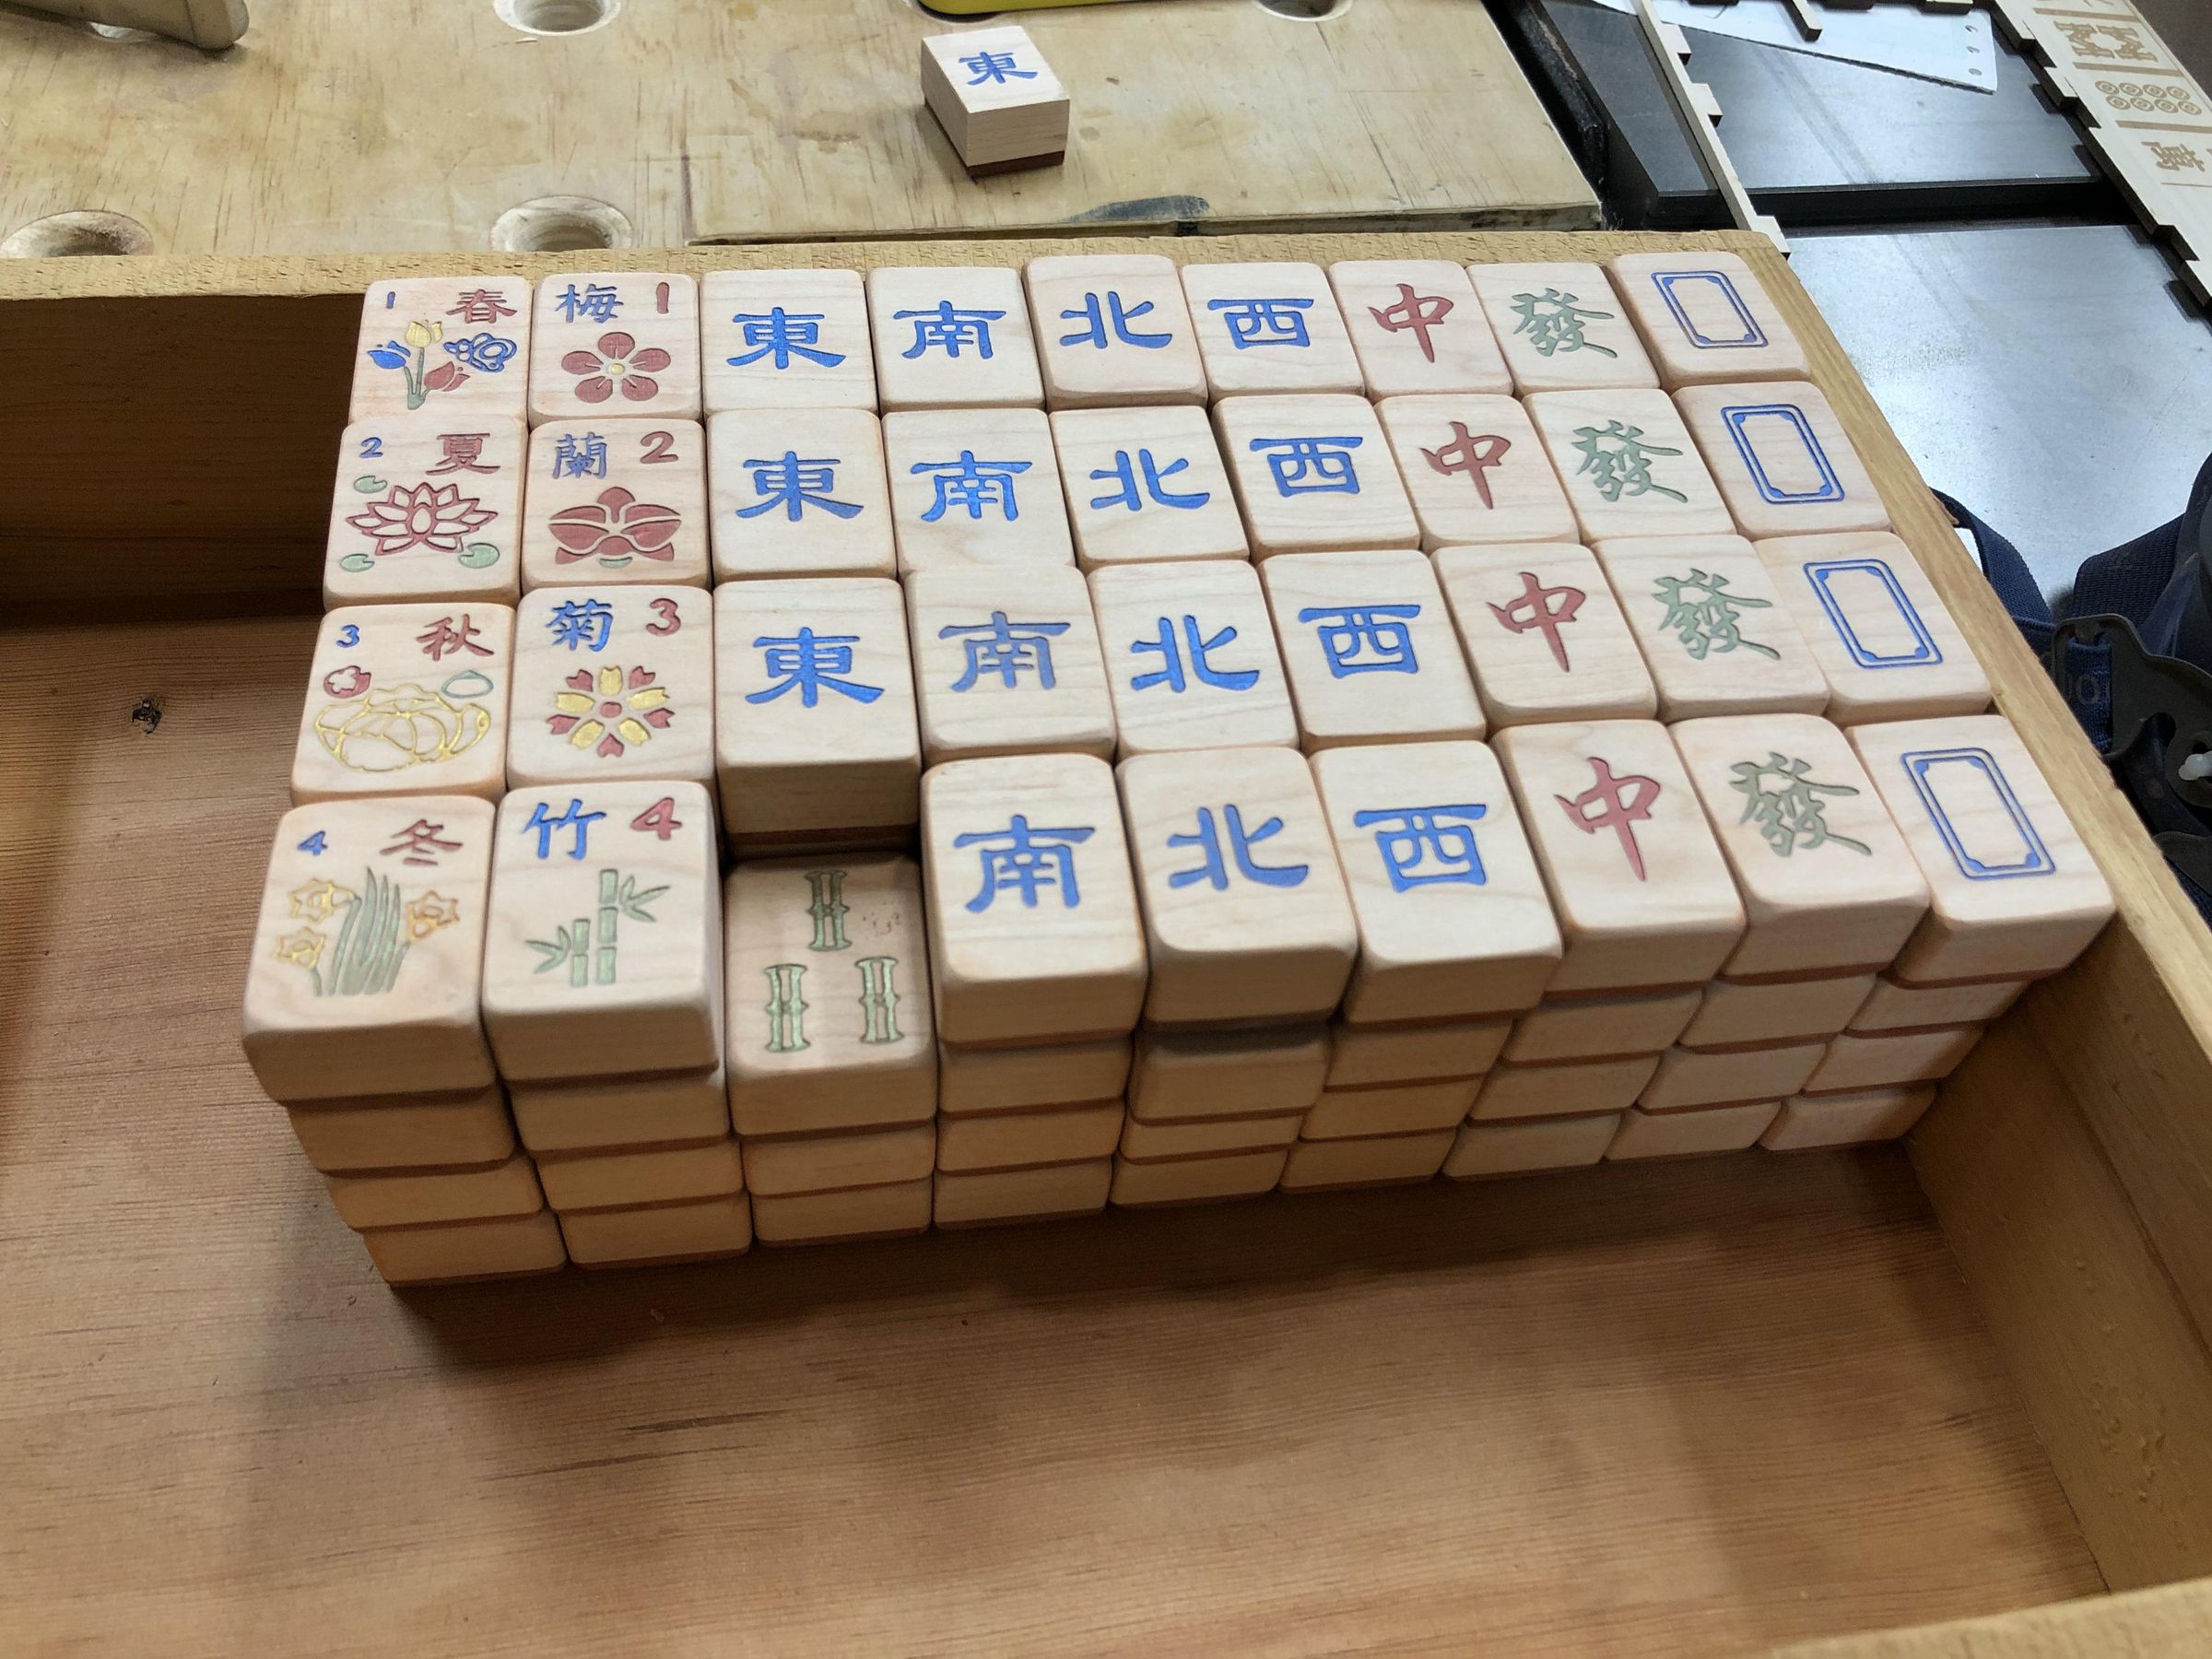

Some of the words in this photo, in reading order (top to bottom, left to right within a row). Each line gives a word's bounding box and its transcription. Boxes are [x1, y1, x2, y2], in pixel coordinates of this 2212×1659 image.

[959, 49, 1040, 87] 東
[385, 291, 396, 310] 1
[446, 289, 517, 324] 春
[555, 284, 624, 324] 梅
[656, 282, 670, 314] 1
[726, 305, 847, 370] 東
[891, 298, 1007, 360] 南
[1060, 290, 1173, 350] 北
[1206, 297, 1315, 351] 西
[1368, 283, 1454, 363] 中
[1510, 288, 1618, 359] 發
[360, 436, 383, 459] 2
[426, 433, 500, 476] 夏
[551, 431, 608, 479] 蘭
[640, 430, 679, 464] 2
[735, 449, 862, 523] 東
[909, 448, 1032, 523] 南
[1089, 447, 1210, 512] 北
[1248, 434, 1365, 499] 西
[1418, 420, 1511, 510] 中
[1571, 419, 1688, 503] 發
[337, 624, 359, 649] 3
[416, 613, 495, 662] 秋
[546, 598, 613, 653] 菊
[646, 597, 682, 636] 3
[1298, 604, 1422, 679] 西
[1486, 571, 1586, 673] 中
[1651, 568, 1779, 660] 發
[745, 625, 885, 708] 東
[938, 612, 1070, 692] 南
[1129, 613, 1261, 693] 北
[523, 798, 606, 860] 竹
[629, 797, 683, 841] 4
[1553, 757, 1661, 882] 中
[1729, 751, 1871, 857] 發
[299, 831, 324, 855] 4
[380, 818, 464, 866] 冬
[952, 814, 1094, 913] 南
[1167, 804, 1310, 891] 北
[1353, 803, 1488, 895] 西
